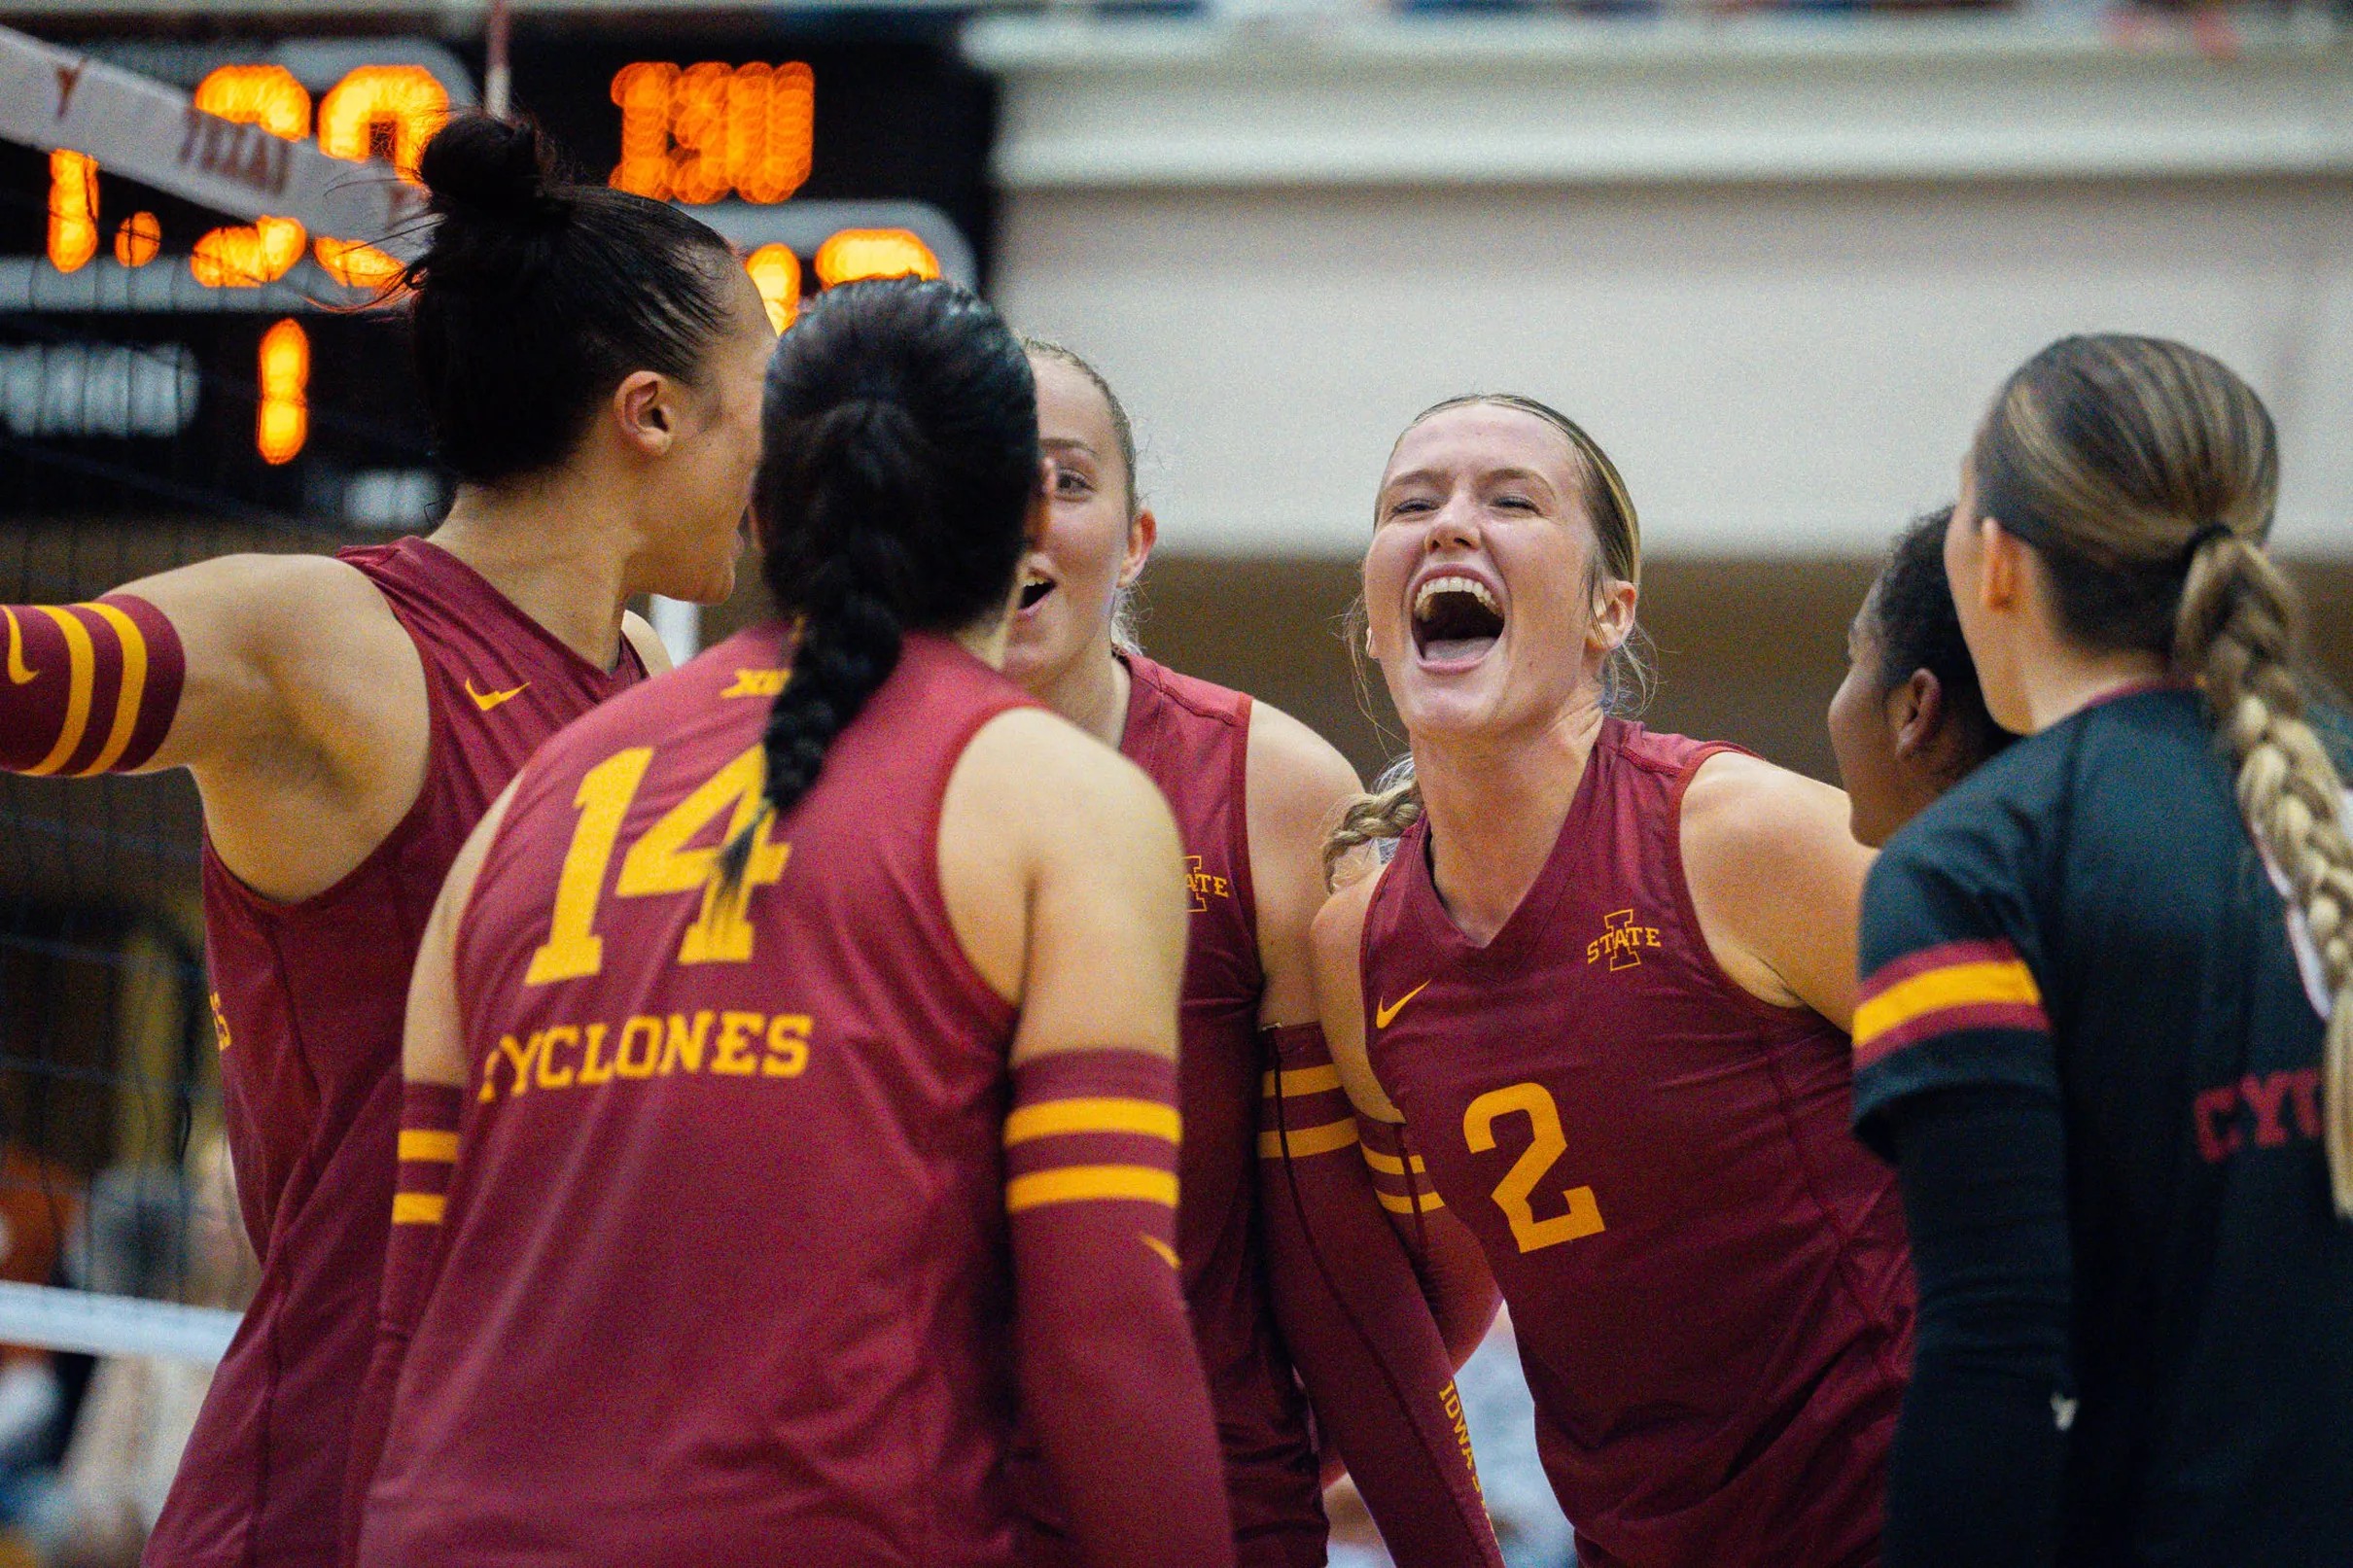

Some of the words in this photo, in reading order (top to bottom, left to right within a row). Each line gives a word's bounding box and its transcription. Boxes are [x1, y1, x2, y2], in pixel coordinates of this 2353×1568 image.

[525, 745, 792, 988] 14
[1587, 926, 1662, 964] STATE
[1463, 1082, 1606, 1254] 2
